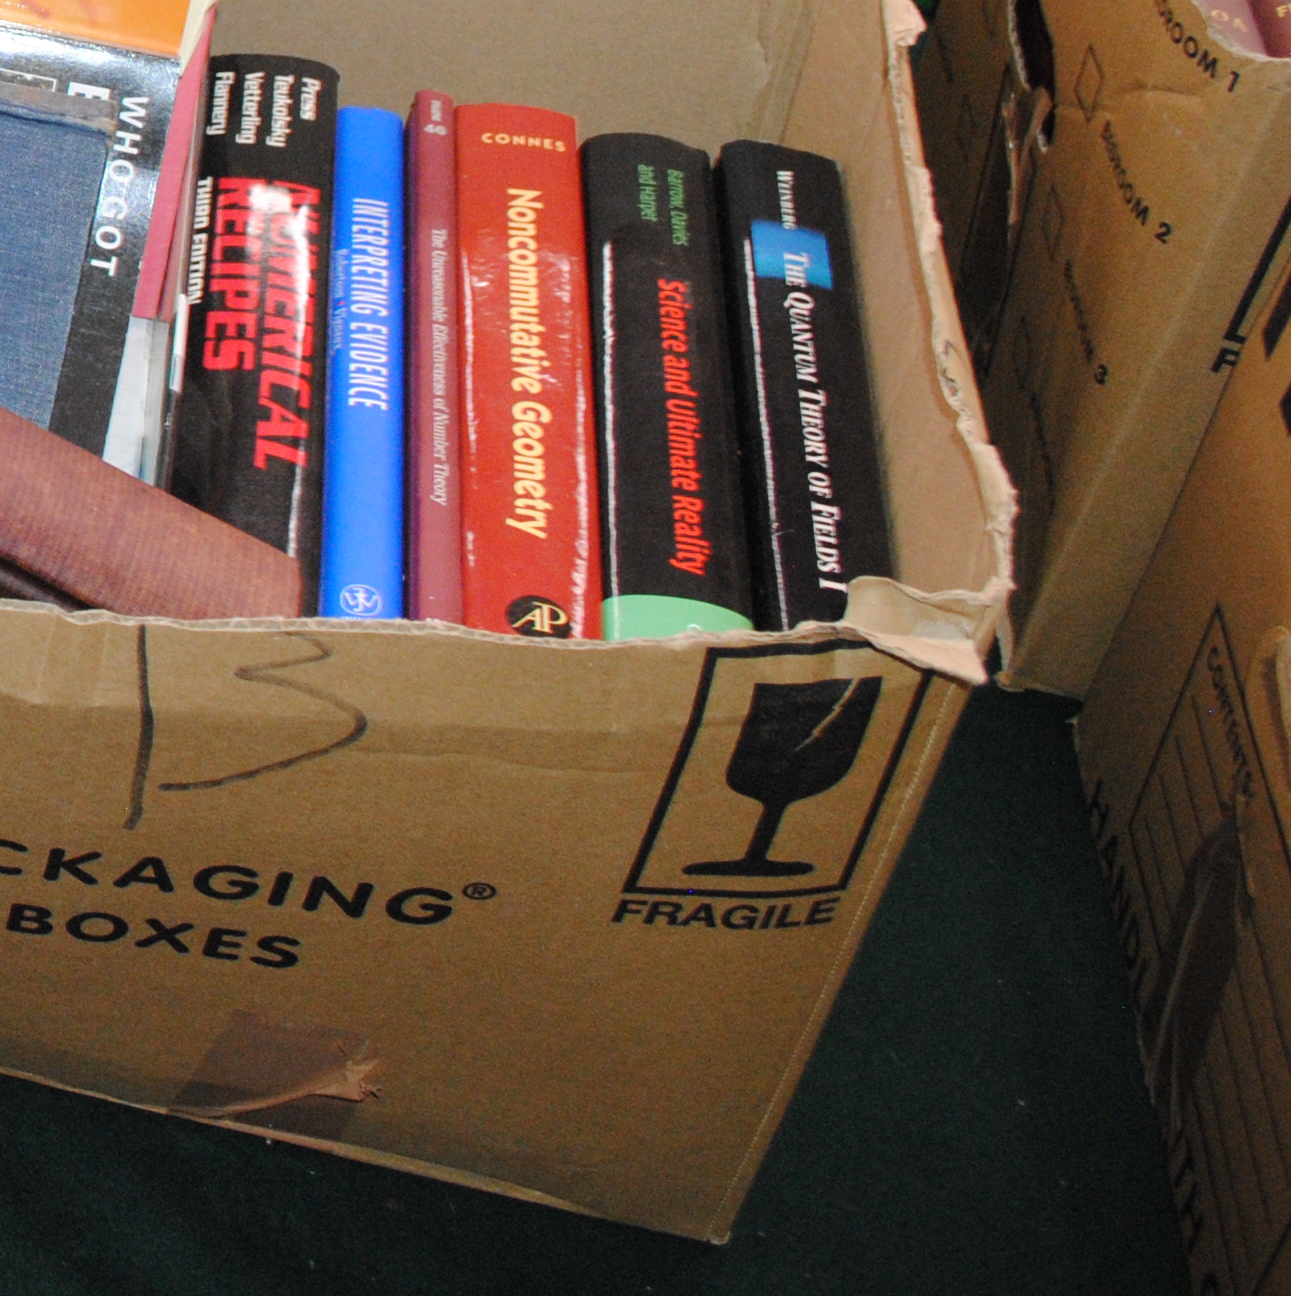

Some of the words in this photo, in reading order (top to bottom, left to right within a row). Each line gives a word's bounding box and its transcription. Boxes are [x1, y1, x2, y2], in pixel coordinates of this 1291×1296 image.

[205, 70, 236, 137] Flannery
[234, 70, 266, 145] Vetterling
[265, 73, 295, 149] Teukolsky
[300, 77, 322, 122] Press
[1226, 70, 1242, 94] 1
[107, 94, 151, 184] WHO
[480, 131, 567, 153] CONNES
[636, 163, 658, 186] and
[89, 194, 131, 278] GOT
[193, 175, 215, 229] THIRD
[638, 184, 659, 223] Harper
[669, 207, 690, 247] Davies
[1152, 219, 1175, 250] 2
[202, 175, 267, 372] RECIPES
[349, 196, 391, 319] INTERPRETING
[431, 227, 449, 249] The
[782, 251, 811, 288] THE
[431, 249, 449, 323] Unreasonable
[505, 186, 552, 395] Noncommutative
[657, 277, 694, 354] Science
[253, 178, 322, 471] NUMERICAL
[432, 322, 450, 396] Effectiveness
[782, 291, 820, 385] QUANTUM
[347, 321, 390, 412] EVIDENCE
[662, 354, 700, 398] and
[1091, 362, 1110, 389] 3
[432, 406, 452, 462] Number
[665, 398, 703, 492] Ultimate
[796, 387, 829, 470] THEORY
[429, 462, 451, 507] Theory
[505, 399, 554, 540] Geometry
[806, 470, 834, 500] OF
[668, 494, 714, 577] Reality
[809, 500, 842, 576] FIELDS
[3, 902, 303, 970] BOXES
[612, 896, 842, 934] FRAGILE
